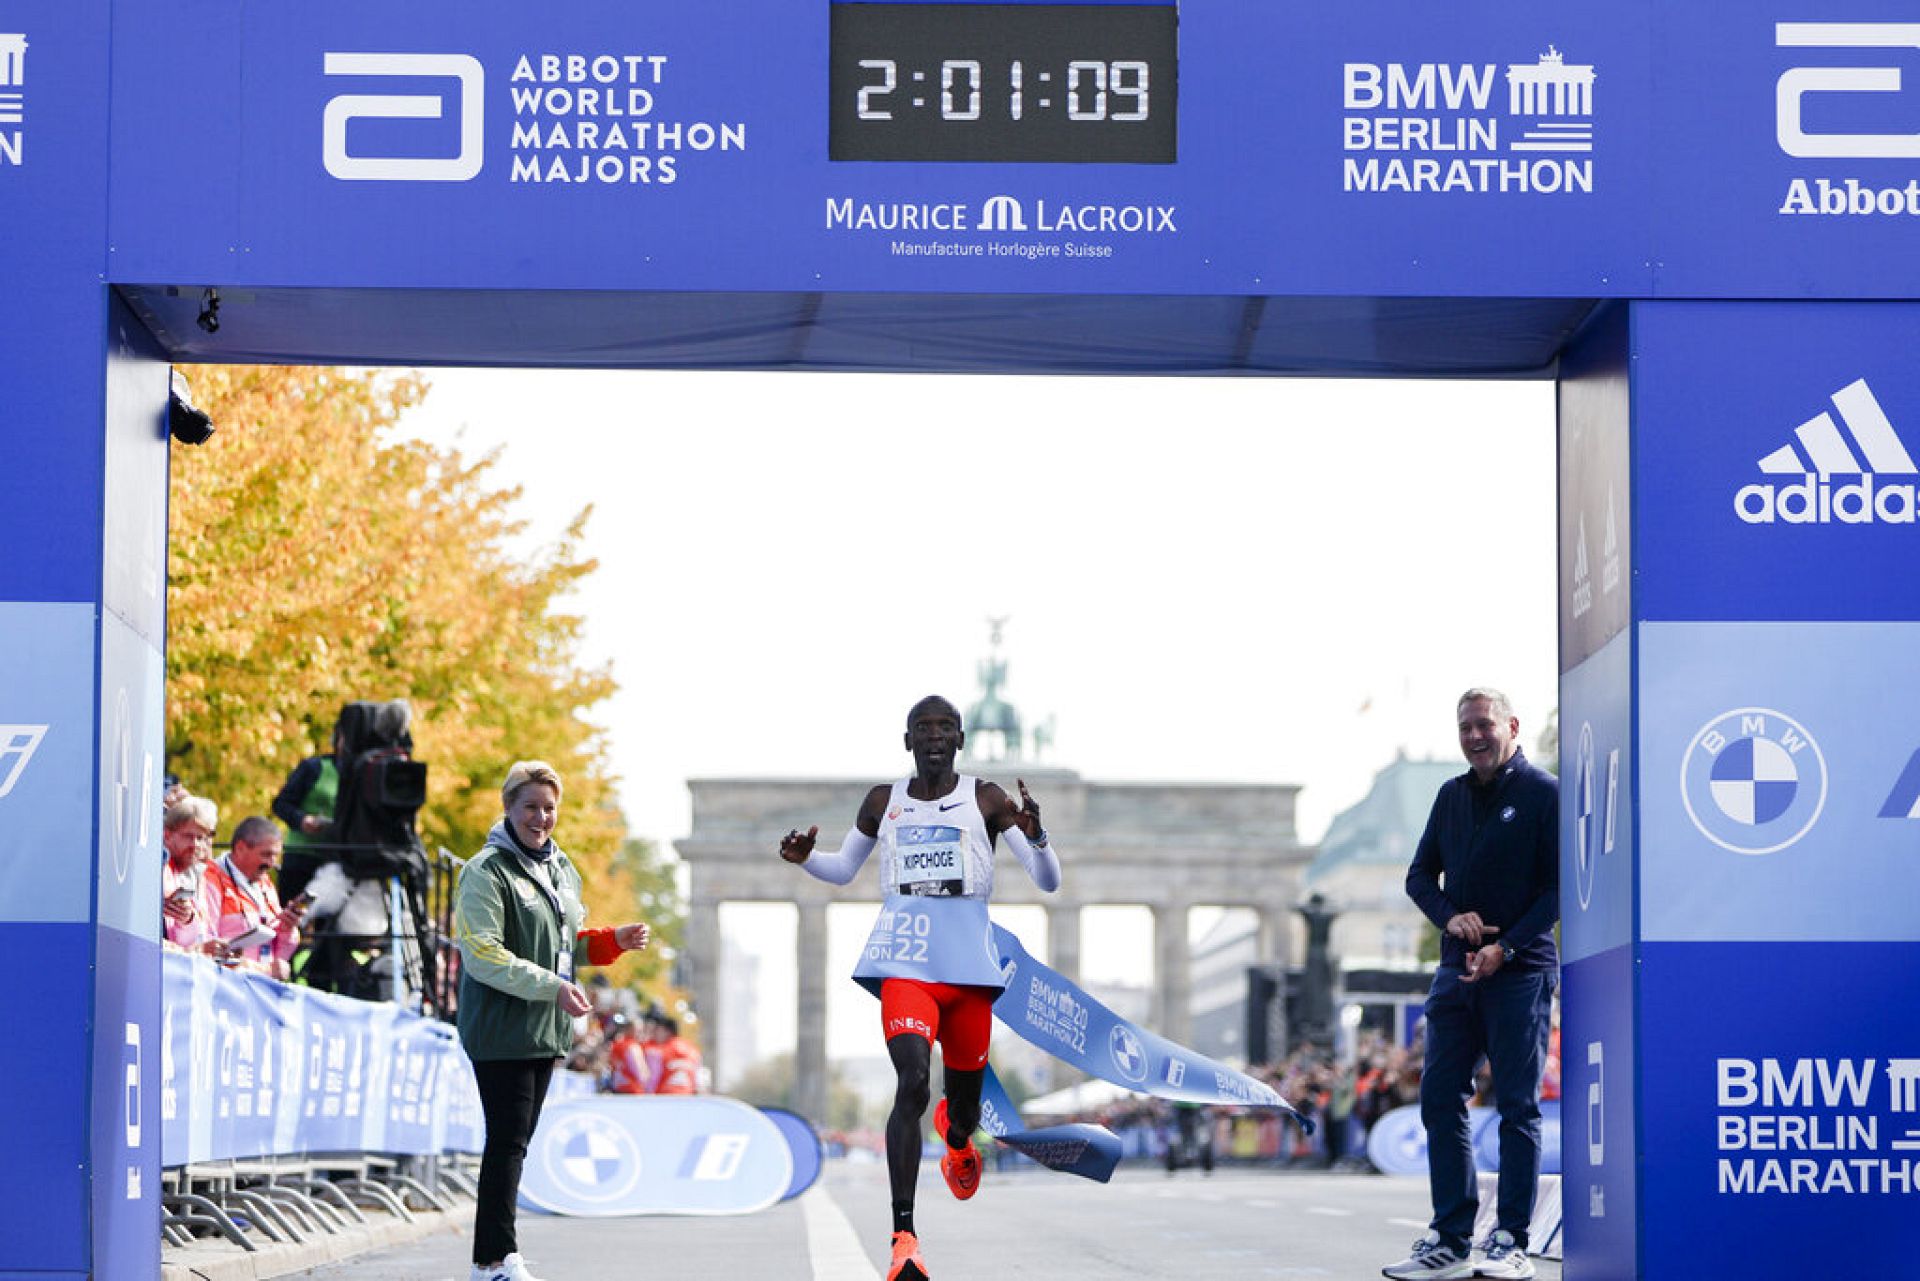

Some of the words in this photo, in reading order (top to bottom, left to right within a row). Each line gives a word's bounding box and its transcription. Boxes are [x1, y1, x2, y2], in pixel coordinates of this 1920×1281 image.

[511, 54, 667, 84] ABBOTT
[511, 87, 654, 117] WORLD
[857, 59, 1149, 121] 2:01:09
[1343, 63, 1497, 110] BMW
[511, 121, 746, 151] MARATHON
[1343, 117, 1497, 151] BERLIN
[511, 154, 677, 185] MAJORS
[1343, 158, 1593, 194] MARATHON
[825, 198, 967, 230] MAURICE
[1037, 199, 1177, 232] LACROIX
[891, 241, 984, 256] Manufacture
[988, 241, 1060, 260] Horlogère
[1064, 243, 1113, 257] Suisse
[1734, 472, 1920, 523] adida
[1700, 715, 1807, 757] BMW
[904, 851, 955, 870] KIPCHOGE
[896, 912, 931, 937] 20
[894, 937, 929, 961] 22
[1030, 975, 1060, 1008] BMW
[1718, 1058, 1876, 1106] BMW
[1718, 1115, 1878, 1150] BERLIN
[1719, 1159, 1920, 1193] MARATH
